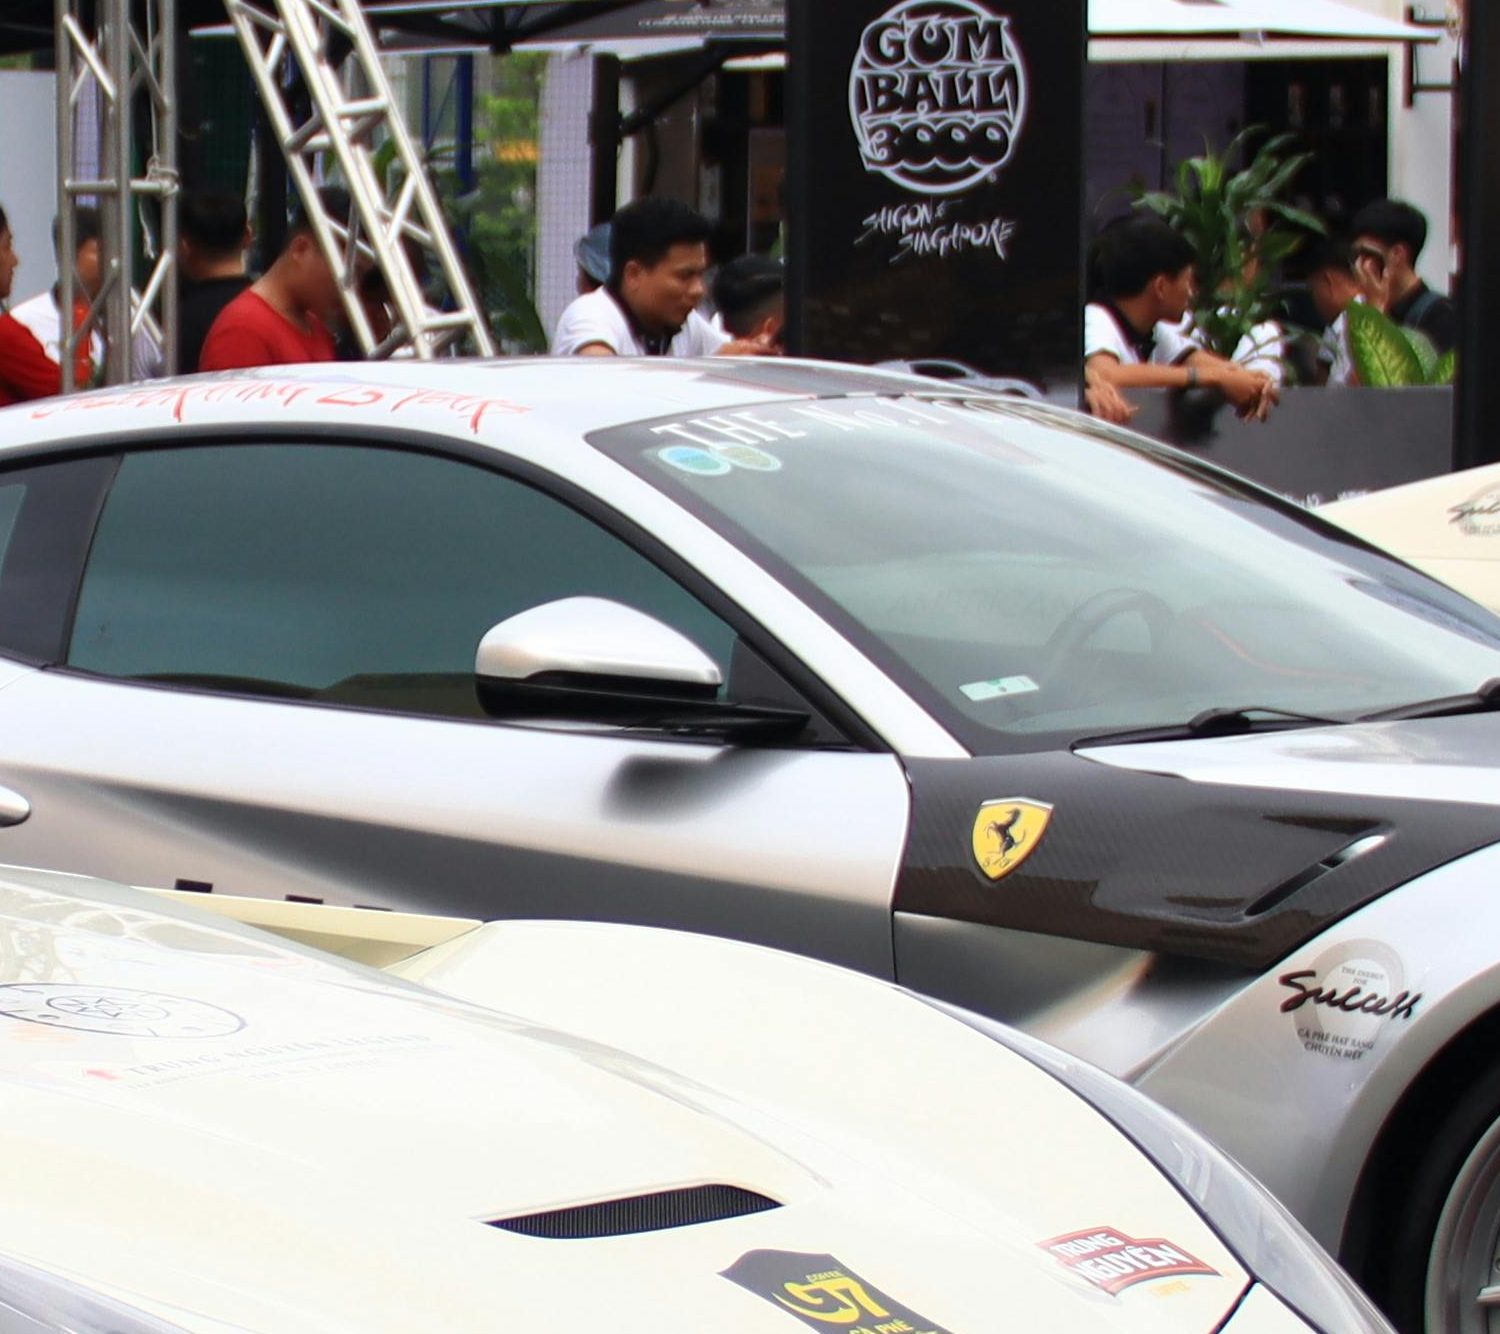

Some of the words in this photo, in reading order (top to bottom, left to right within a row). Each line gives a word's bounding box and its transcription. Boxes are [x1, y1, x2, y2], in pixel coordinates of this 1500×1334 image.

[860, 12, 1010, 68] GUM
[855, 65, 1016, 120] BALL
[859, 118, 1012, 171] 3000
[649, 410, 807, 451] THE
[1277, 969, 1423, 1020] Success
[1050, 1232, 1126, 1258] TRUNG
[1072, 1243, 1193, 1285] NGUYÊN
[770, 1276, 891, 1325] G7
